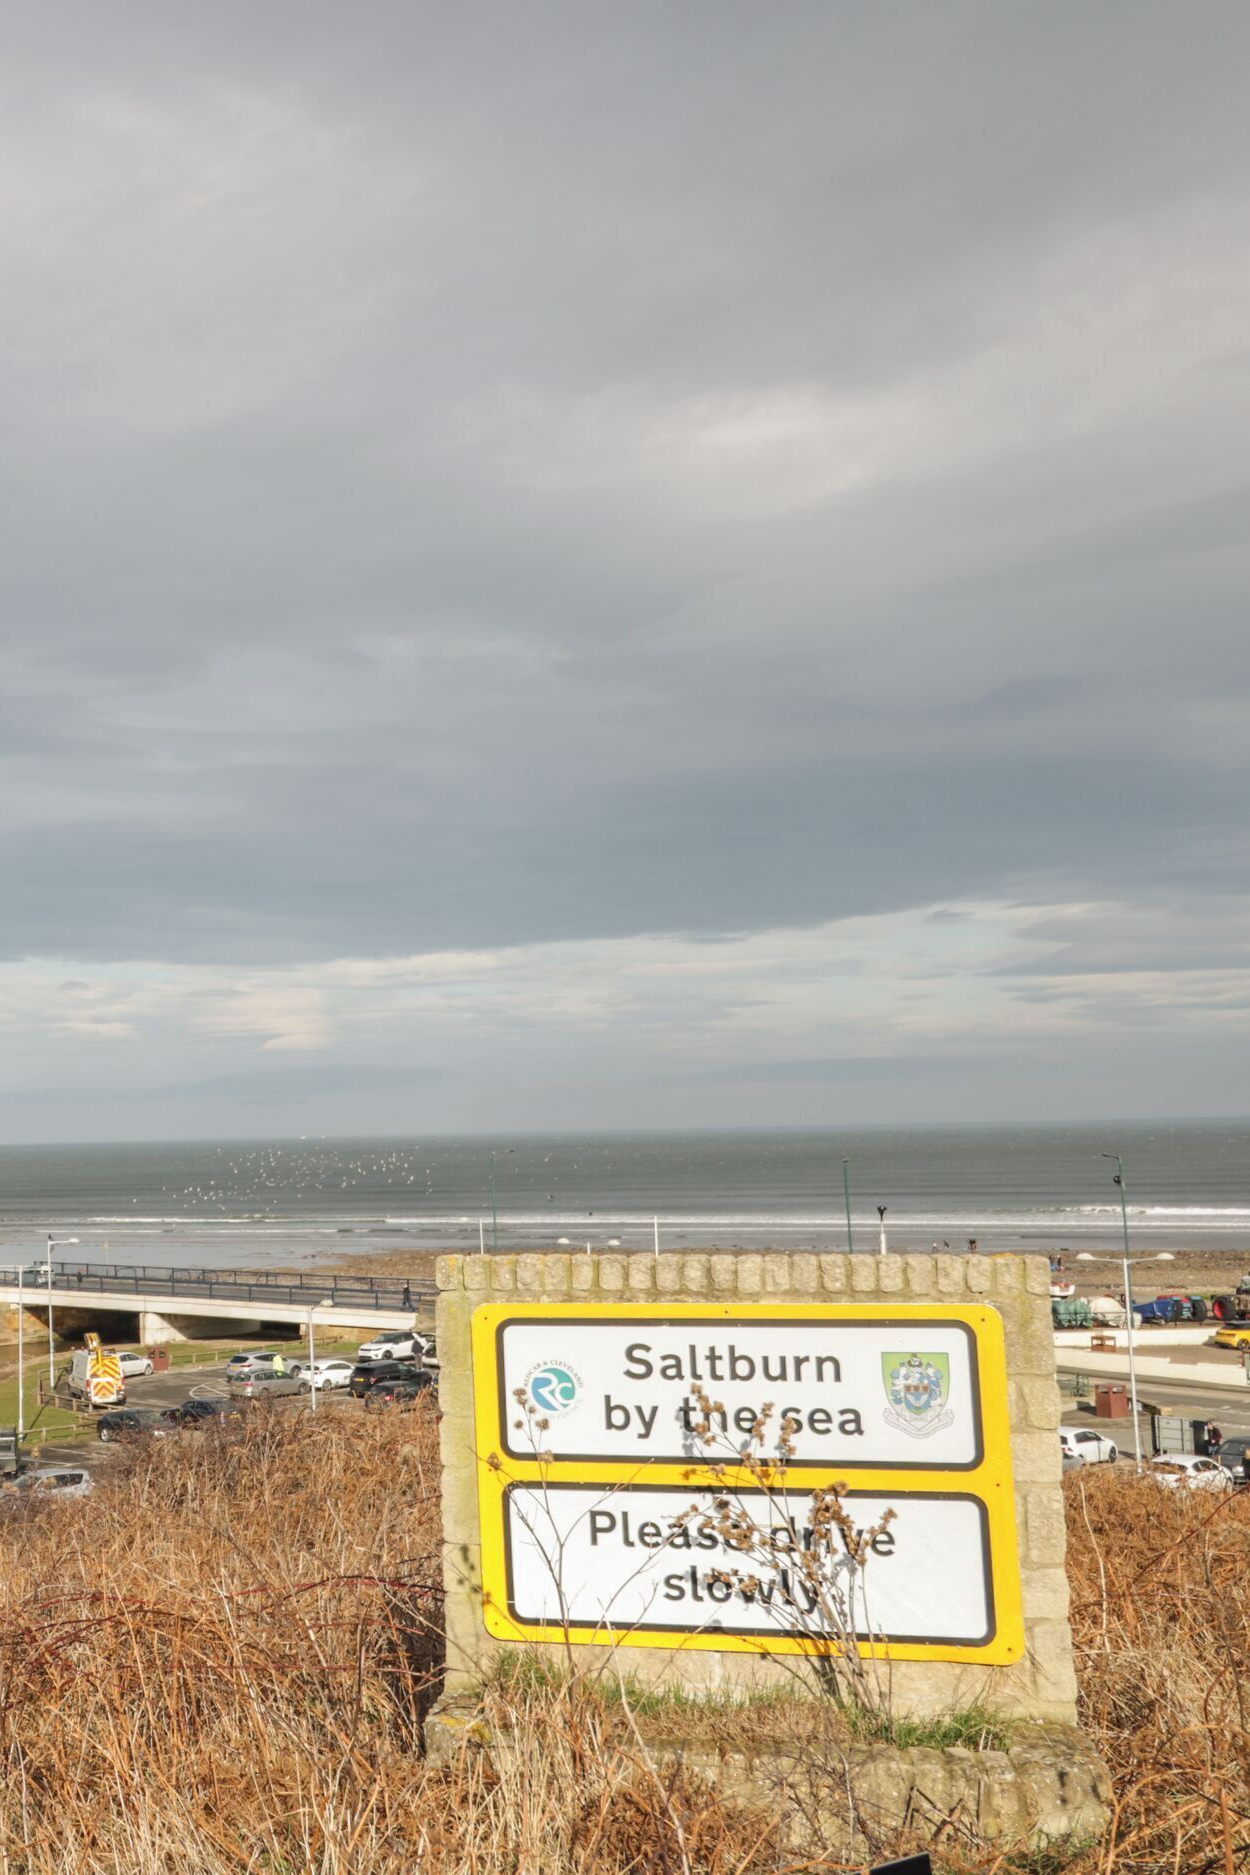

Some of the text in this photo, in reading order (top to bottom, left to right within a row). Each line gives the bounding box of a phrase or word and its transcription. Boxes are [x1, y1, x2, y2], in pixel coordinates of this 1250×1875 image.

[550, 1359, 583, 1388] CLEVELAND
[623, 1343, 842, 1382] Saltburn
[604, 1394, 659, 1439] by
[679, 1396, 758, 1434] the
[780, 1406, 865, 1436] sea
[663, 1564, 823, 1614] slowly
